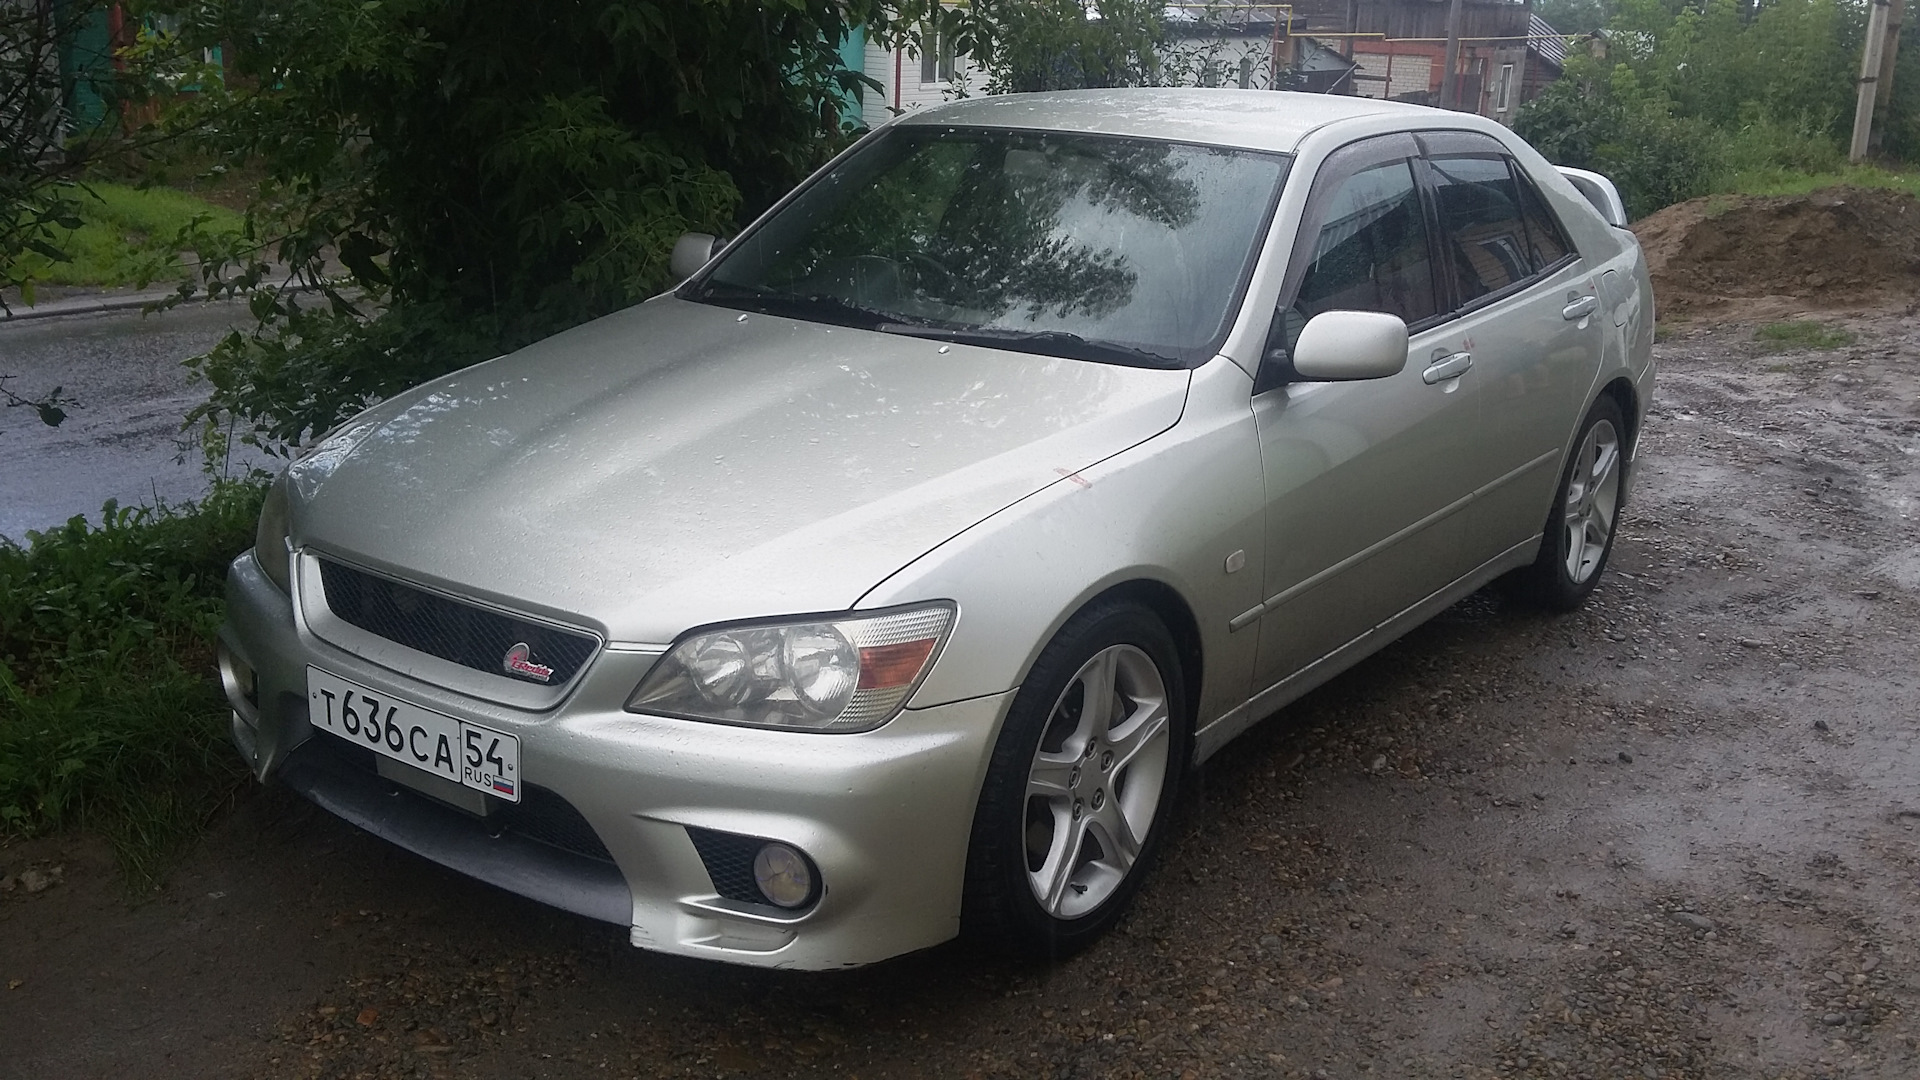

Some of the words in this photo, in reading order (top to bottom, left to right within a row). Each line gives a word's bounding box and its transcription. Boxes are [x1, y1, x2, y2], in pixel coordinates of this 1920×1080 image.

[320, 688, 455, 774] T636CA
[465, 729, 503, 777] 54
[464, 766, 492, 788] RUS
